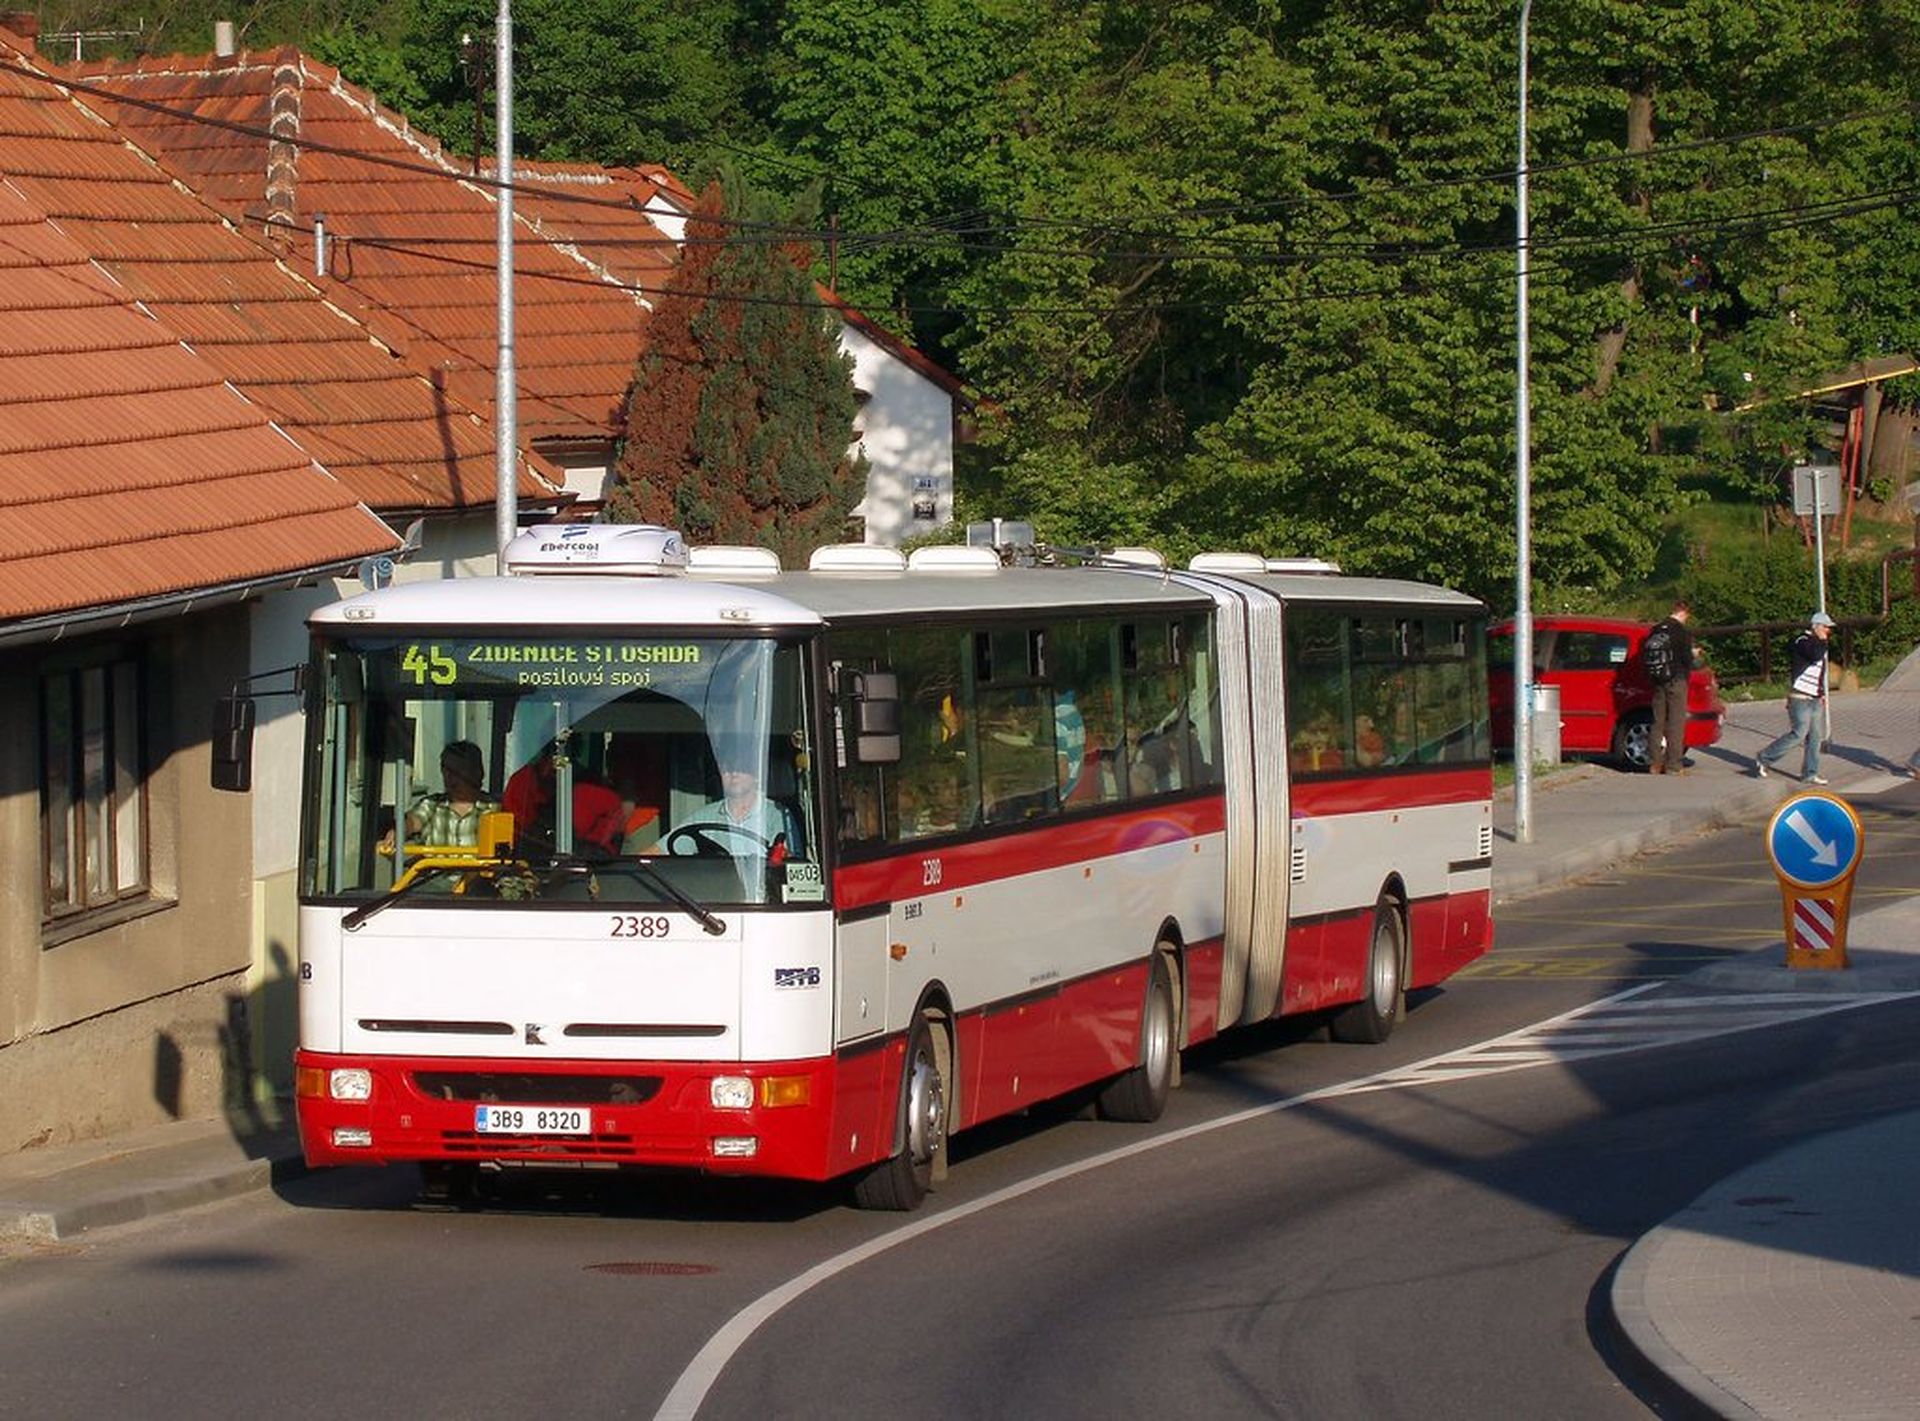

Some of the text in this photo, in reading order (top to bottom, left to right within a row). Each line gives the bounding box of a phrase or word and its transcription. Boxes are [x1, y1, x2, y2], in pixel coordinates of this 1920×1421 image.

[540, 543, 599, 552] Ebercool
[402, 645, 457, 686] 45
[518, 665, 651, 687] posilový spoj
[610, 916, 671, 938] 2389
[490, 1110, 524, 1129] 3B9
[537, 1111, 581, 1130] 8320
